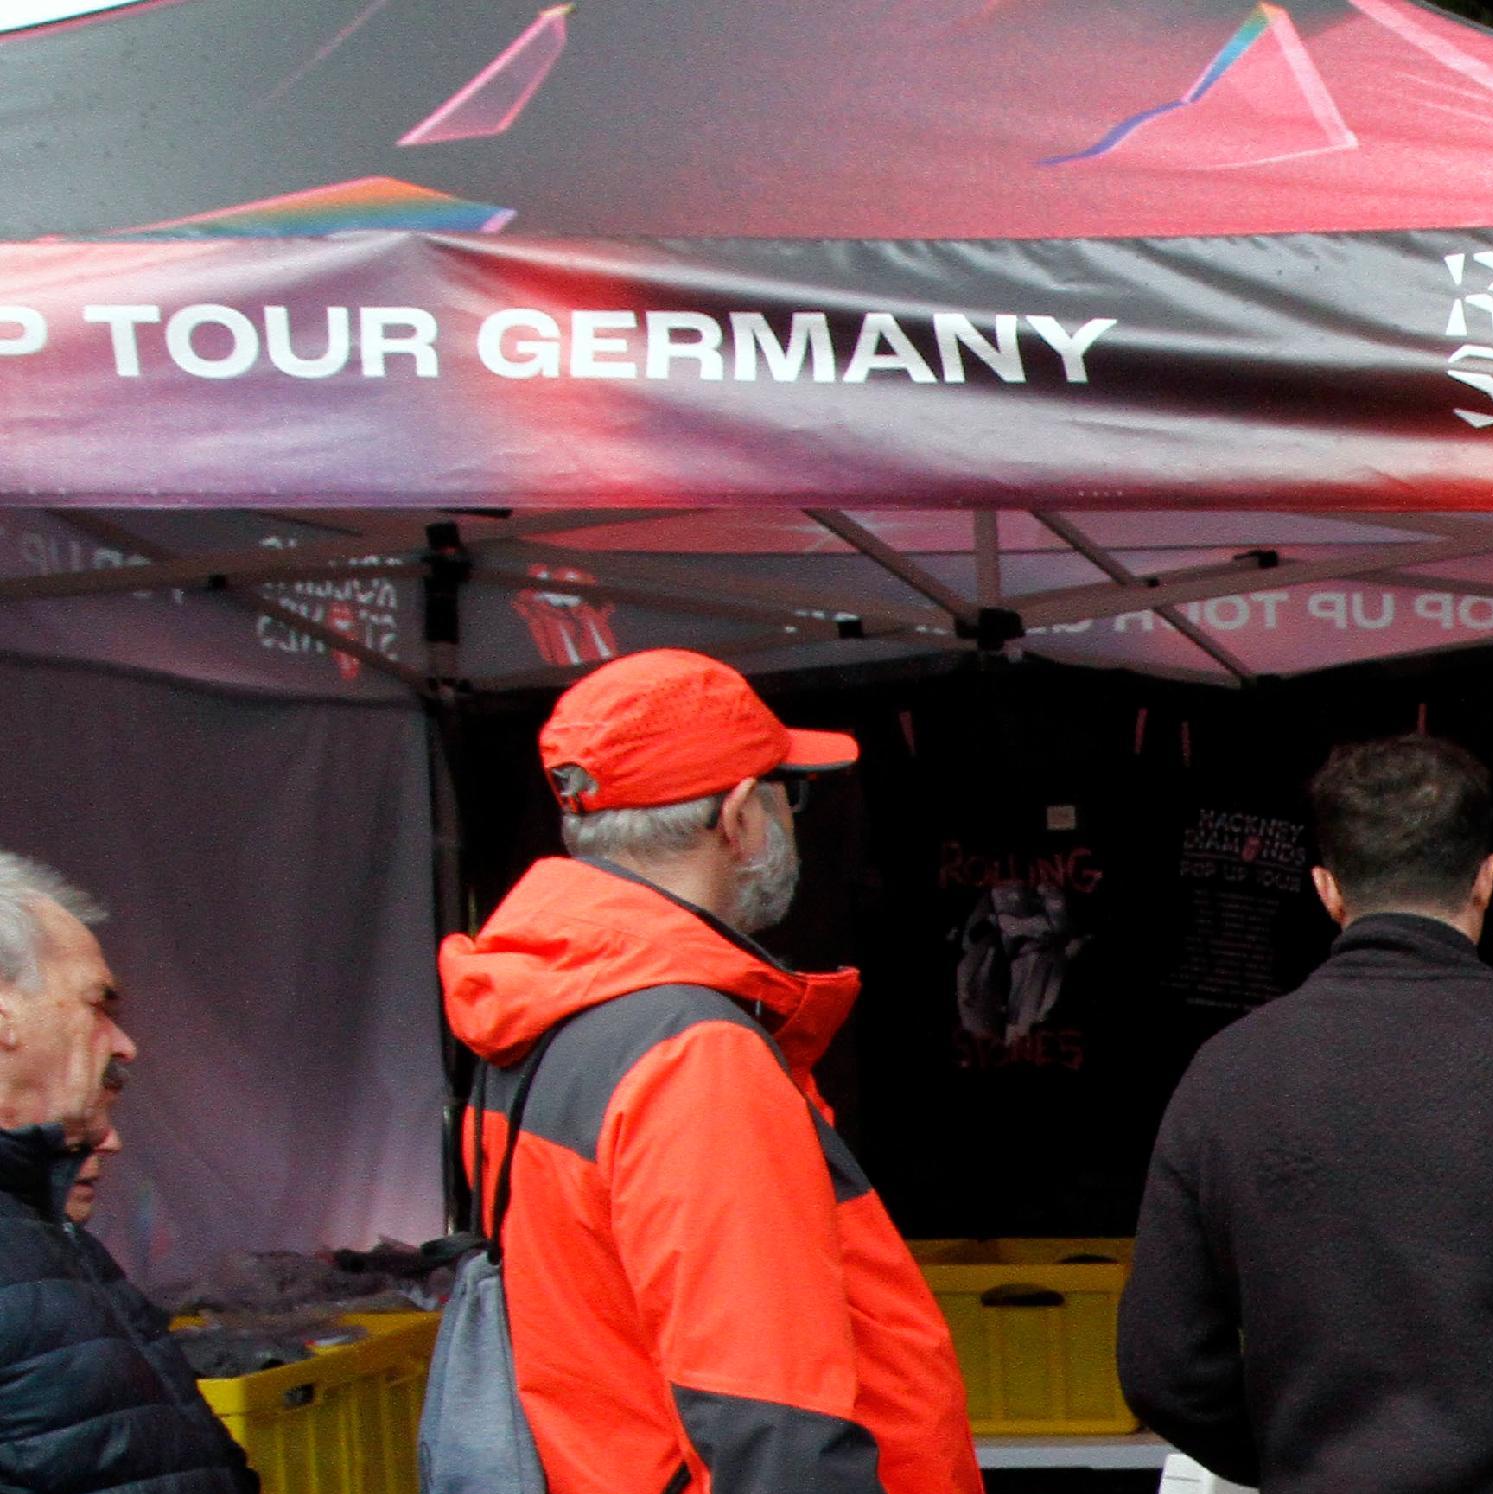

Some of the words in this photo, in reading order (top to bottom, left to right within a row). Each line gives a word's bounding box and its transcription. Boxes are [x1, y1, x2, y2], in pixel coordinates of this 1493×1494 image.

[0, 305, 48, 355] P
[83, 303, 439, 379] TOUR
[476, 307, 1118, 384] GERMANY
[937, 838, 1105, 895] ROLLING
